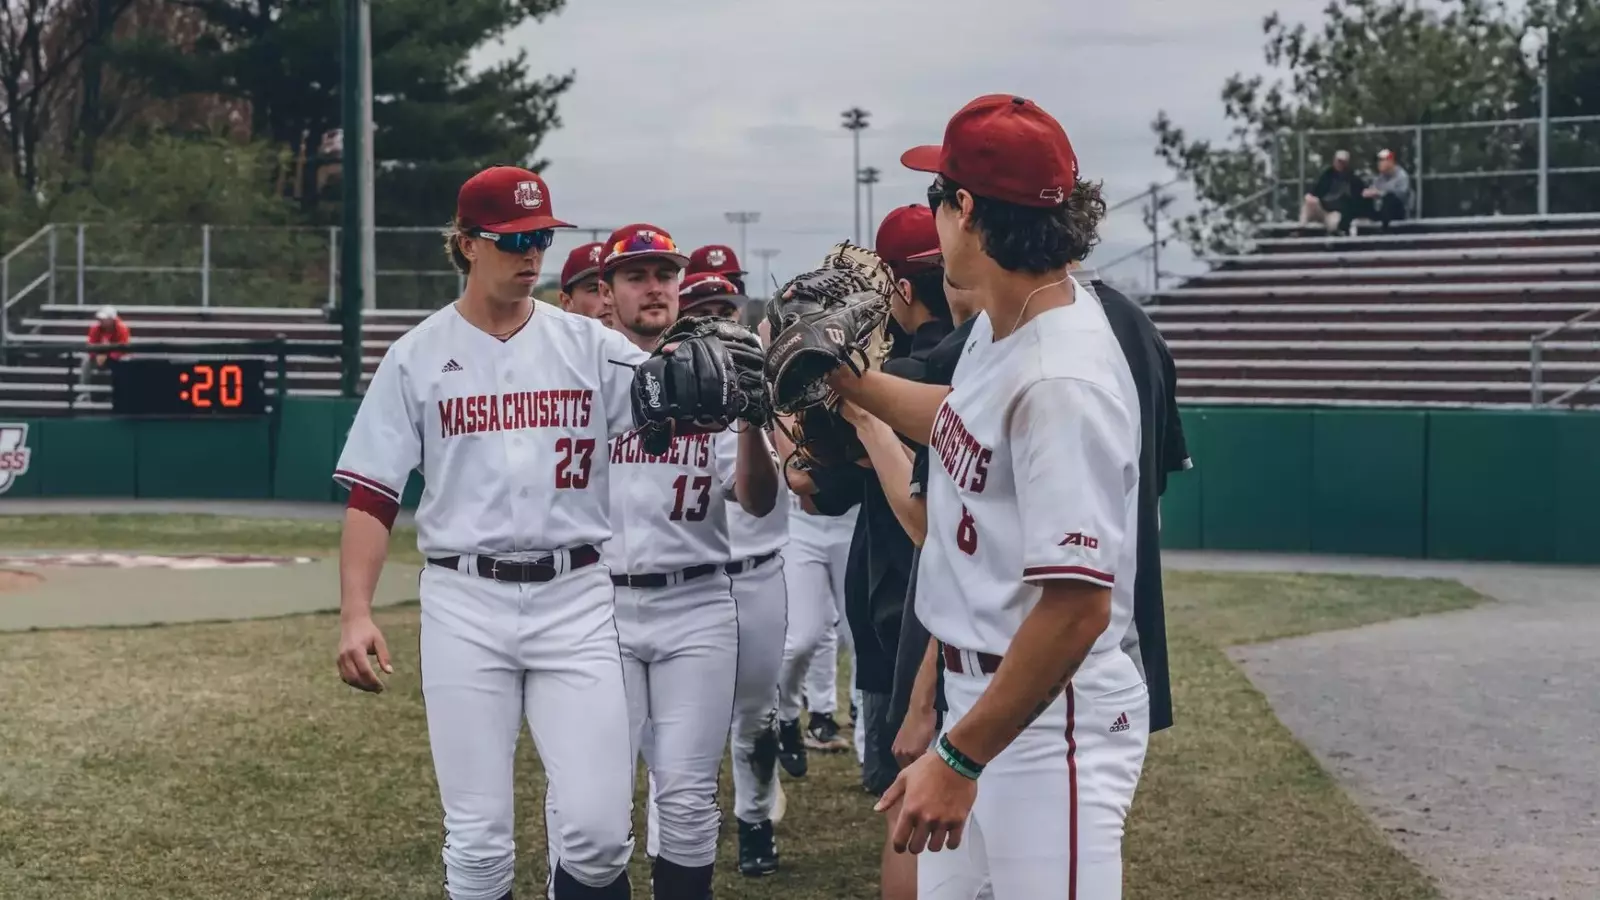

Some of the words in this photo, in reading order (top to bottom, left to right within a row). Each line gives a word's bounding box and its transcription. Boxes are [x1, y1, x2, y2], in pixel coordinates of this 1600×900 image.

[438, 389, 593, 438] MASSACHUSETTS
[555, 437, 596, 489] 23
[669, 474, 712, 521] 13
